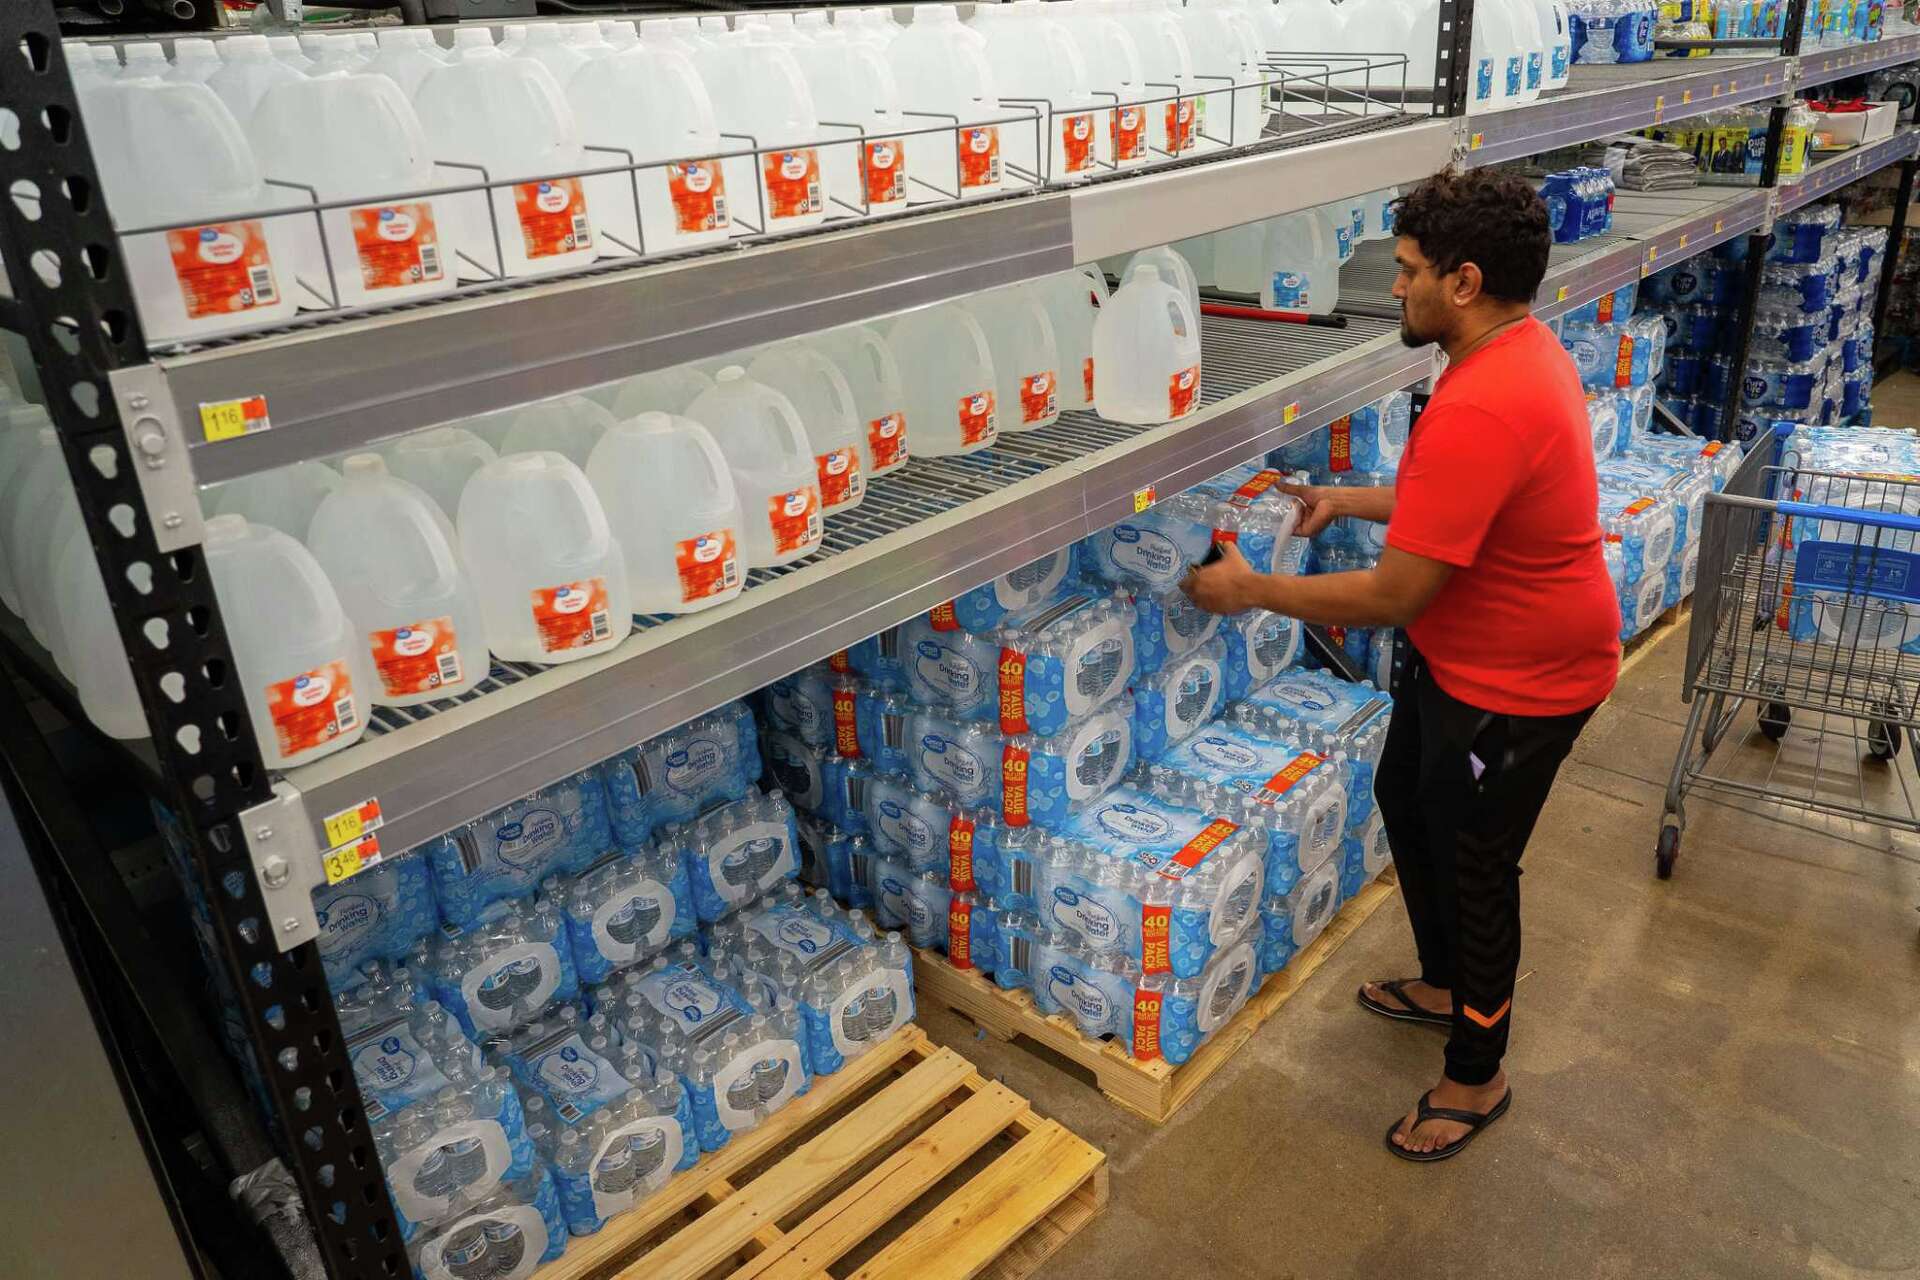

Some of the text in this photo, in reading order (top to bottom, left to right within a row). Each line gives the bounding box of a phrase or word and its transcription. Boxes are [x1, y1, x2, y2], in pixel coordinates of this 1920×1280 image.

[1136, 547, 1171, 563] Drinking
[1000, 661, 1023, 675] 40
[835, 700, 854, 713] 40
[1001, 690, 1011, 720] PACK
[1011, 689, 1023, 720] VALUE
[1004, 759, 1026, 772] 40
[1005, 785, 1014, 815] PACK
[1014, 785, 1025, 815] VALUE
[950, 830, 971, 842] 40
[951, 911, 969, 925] 40
[1145, 915, 1168, 928] 40
[1145, 942, 1156, 968] PACK
[1156, 941, 1168, 968] VALUE
[1071, 990, 1103, 1012] Drinking
[1136, 1000, 1160, 1013] 40
[1135, 1026, 1146, 1052] PACK
